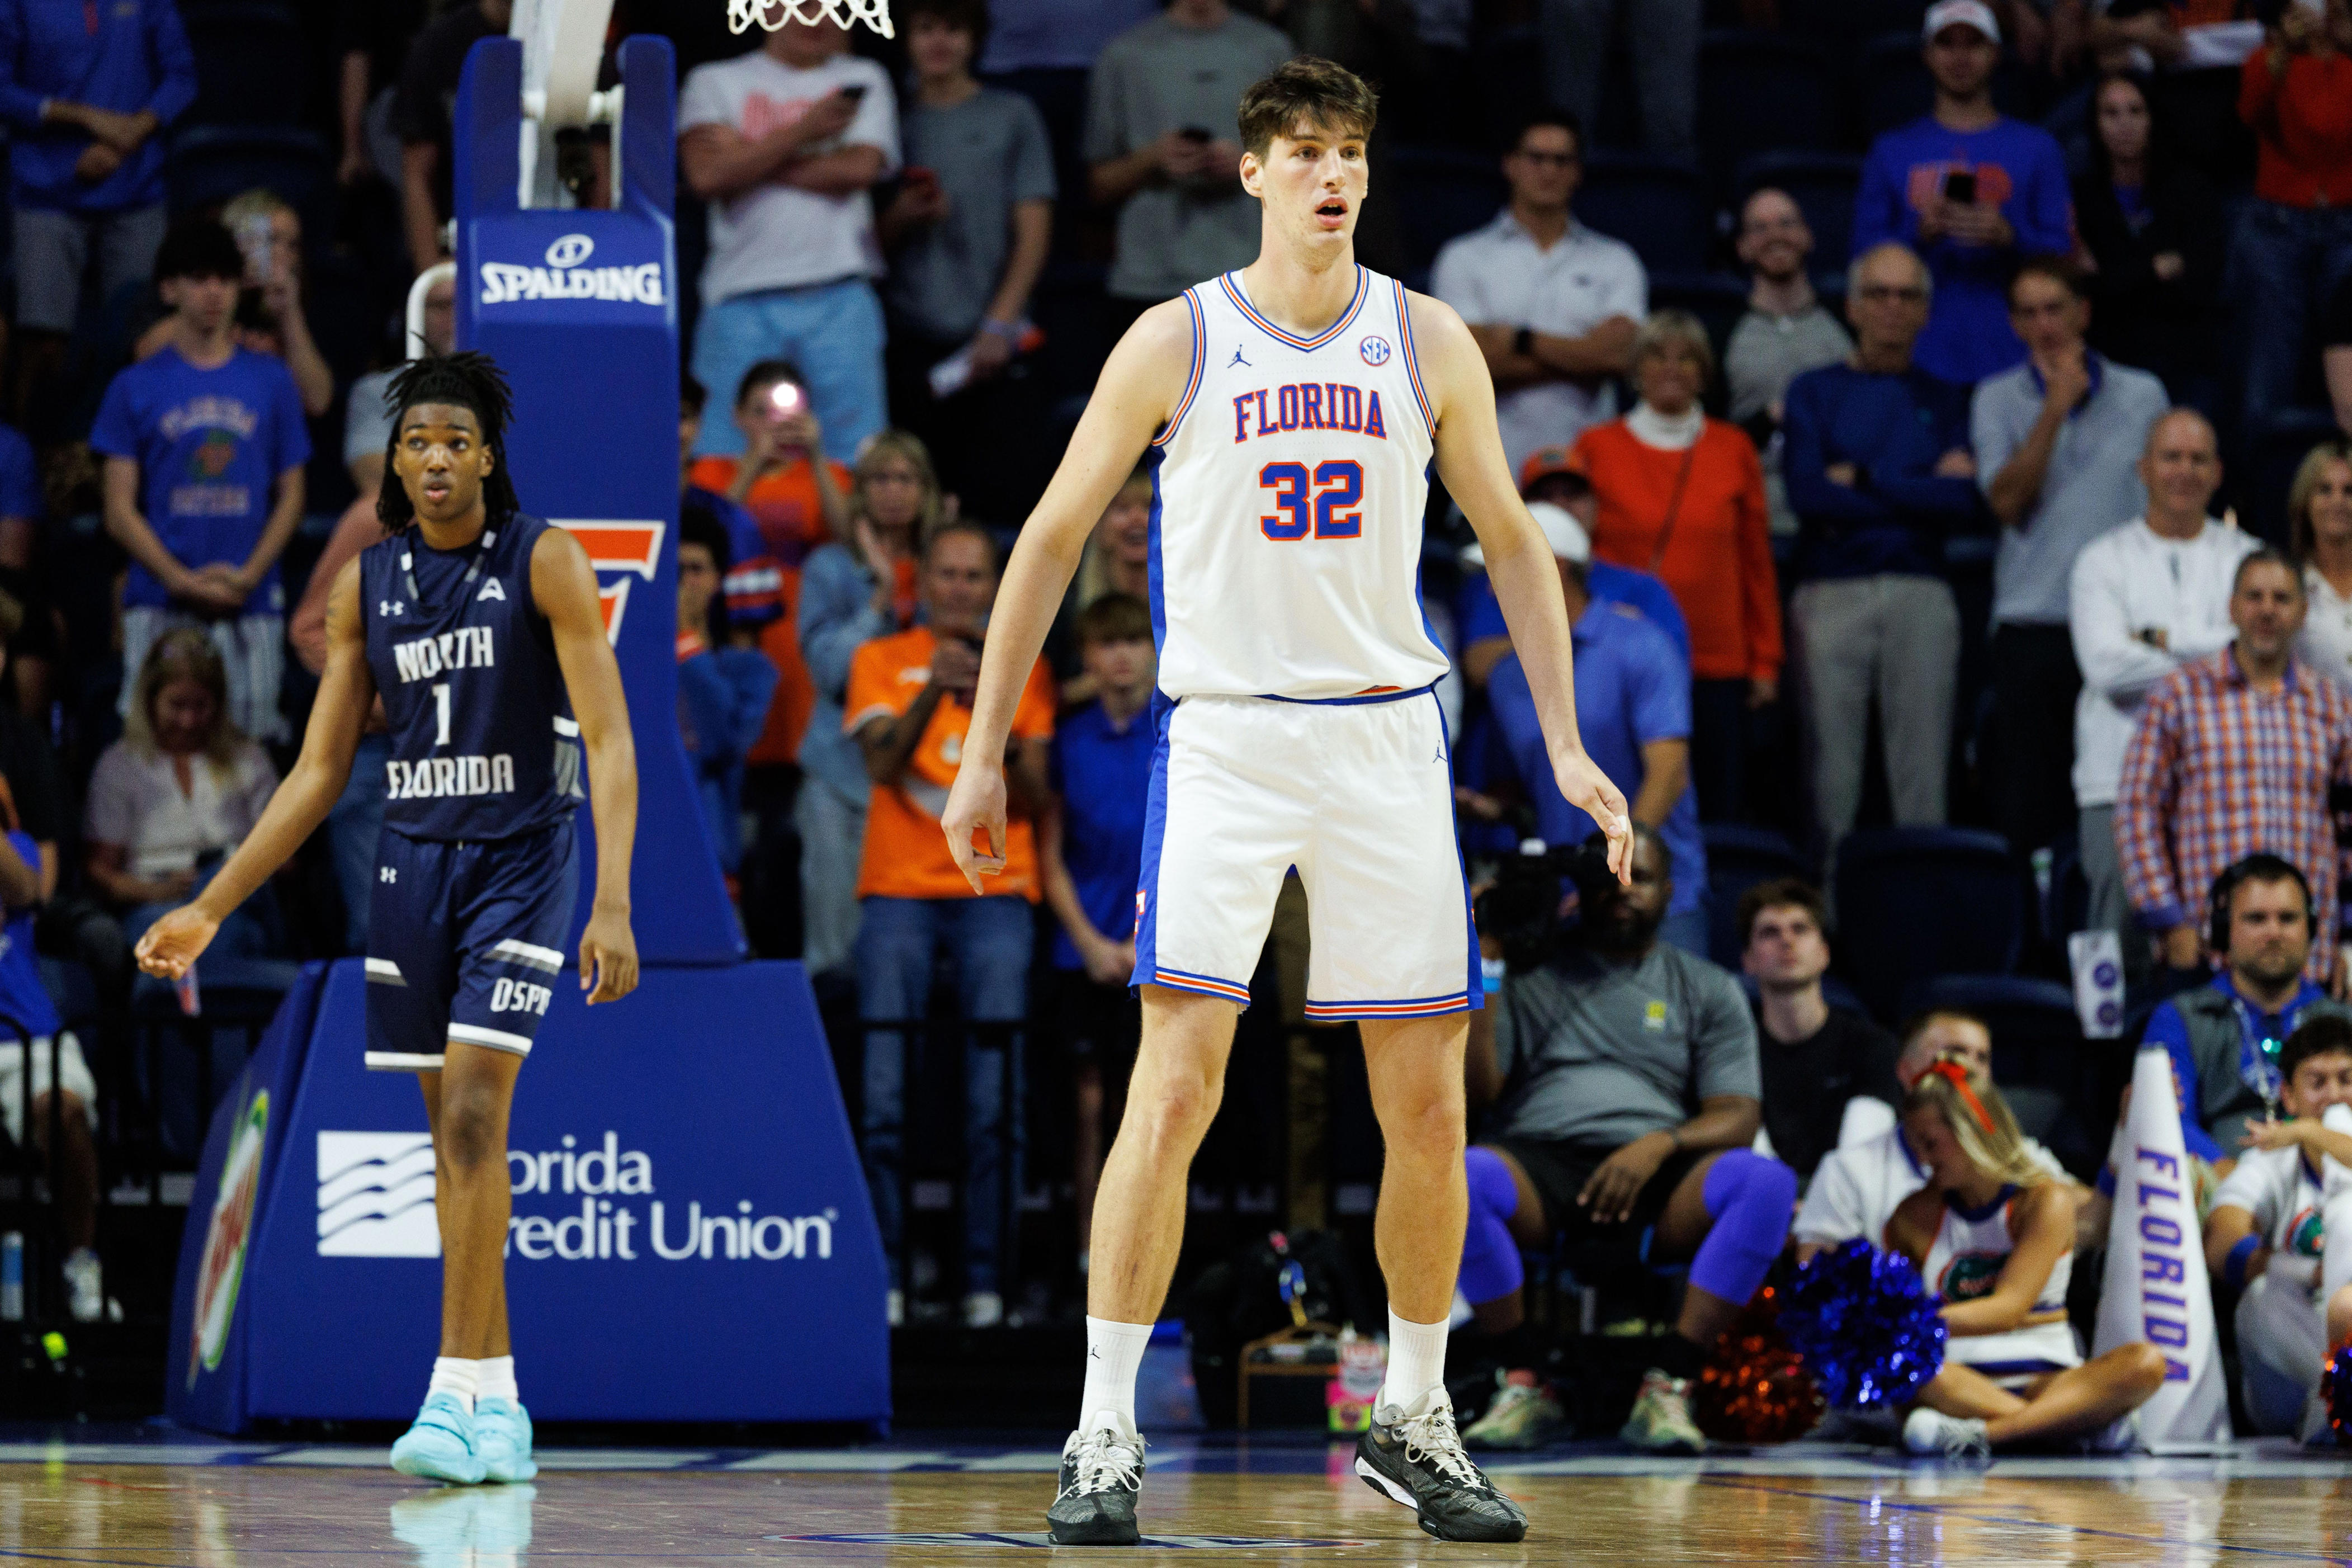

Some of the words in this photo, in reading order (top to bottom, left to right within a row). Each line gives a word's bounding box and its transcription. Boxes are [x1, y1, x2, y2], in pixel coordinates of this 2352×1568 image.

[481, 262, 664, 306] SPALDING
[1362, 337, 1389, 365] SEC
[1233, 382, 1387, 444] FLORIDA
[1259, 460, 1364, 541] 32
[432, 683, 451, 746] 1
[386, 753, 515, 800] FLORIDA
[506, 1130, 653, 1195] orida
[503, 1196, 639, 1260] redit
